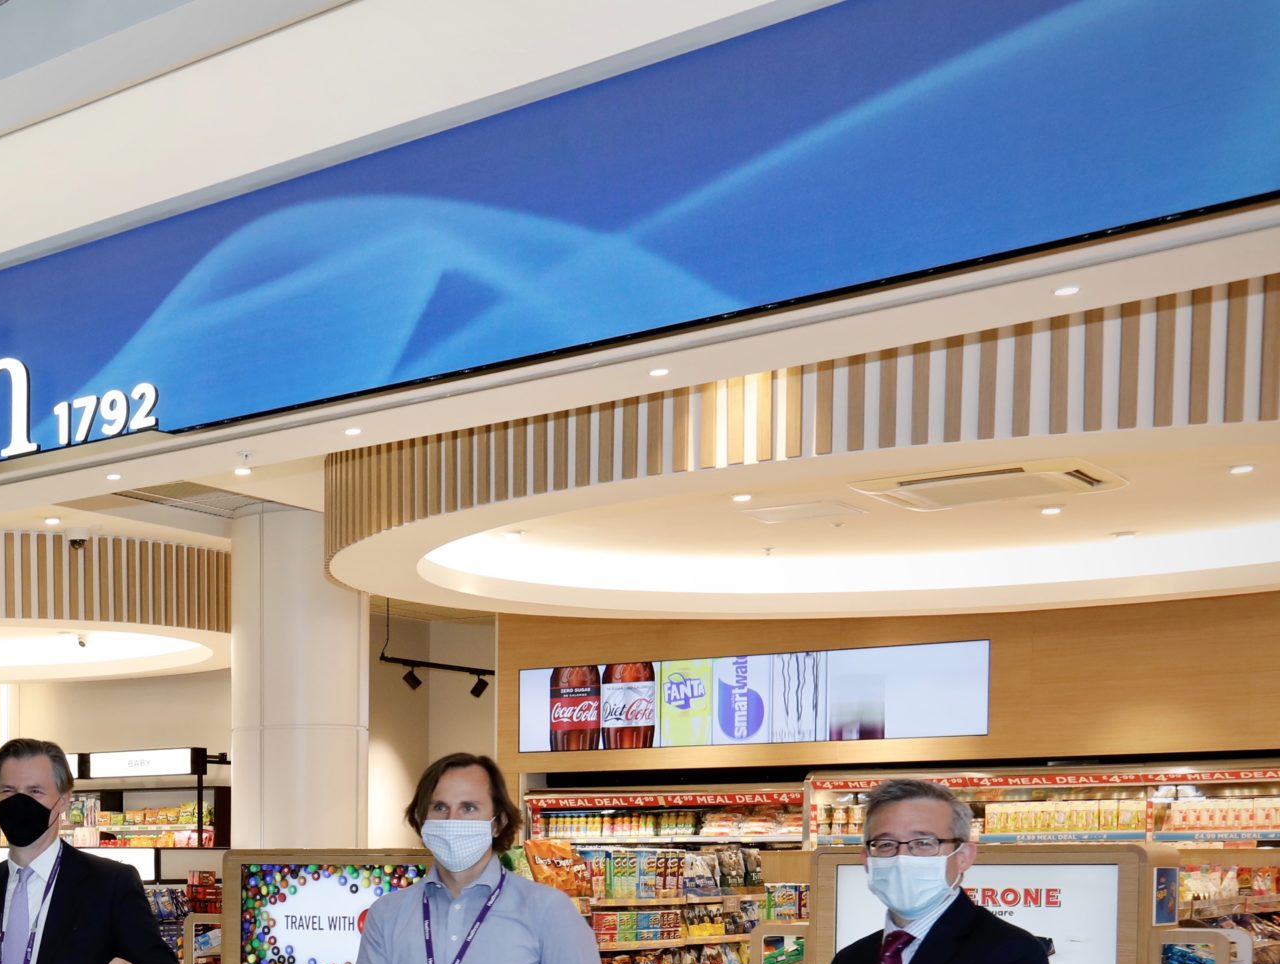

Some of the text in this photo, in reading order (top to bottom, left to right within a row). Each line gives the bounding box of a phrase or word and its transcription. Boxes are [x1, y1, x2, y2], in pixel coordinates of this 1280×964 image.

[53, 382, 158, 445] 1792
[663, 678, 705, 702] FANTA
[732, 656, 748, 739] smartwat
[551, 700, 599, 723] Coca-Cola
[603, 698, 654, 722] Diet Coke
[127, 759, 151, 768] BABY
[1008, 777, 1051, 786] MEAL
[1056, 775, 1099, 784] DEAL
[1240, 771, 1280, 779] DEA
[848, 780, 884, 788] MEA
[558, 799, 593, 807] MEAL
[594, 798, 628, 806] DEAL
[696, 794, 732, 804] MEAL
[735, 794, 772, 803] DEAL
[1241, 831, 1263, 839] DEAL
[963, 888, 1061, 907] ERONE
[990, 908, 1014, 916] uare
[284, 915, 355, 931] TRAVEL WITH
